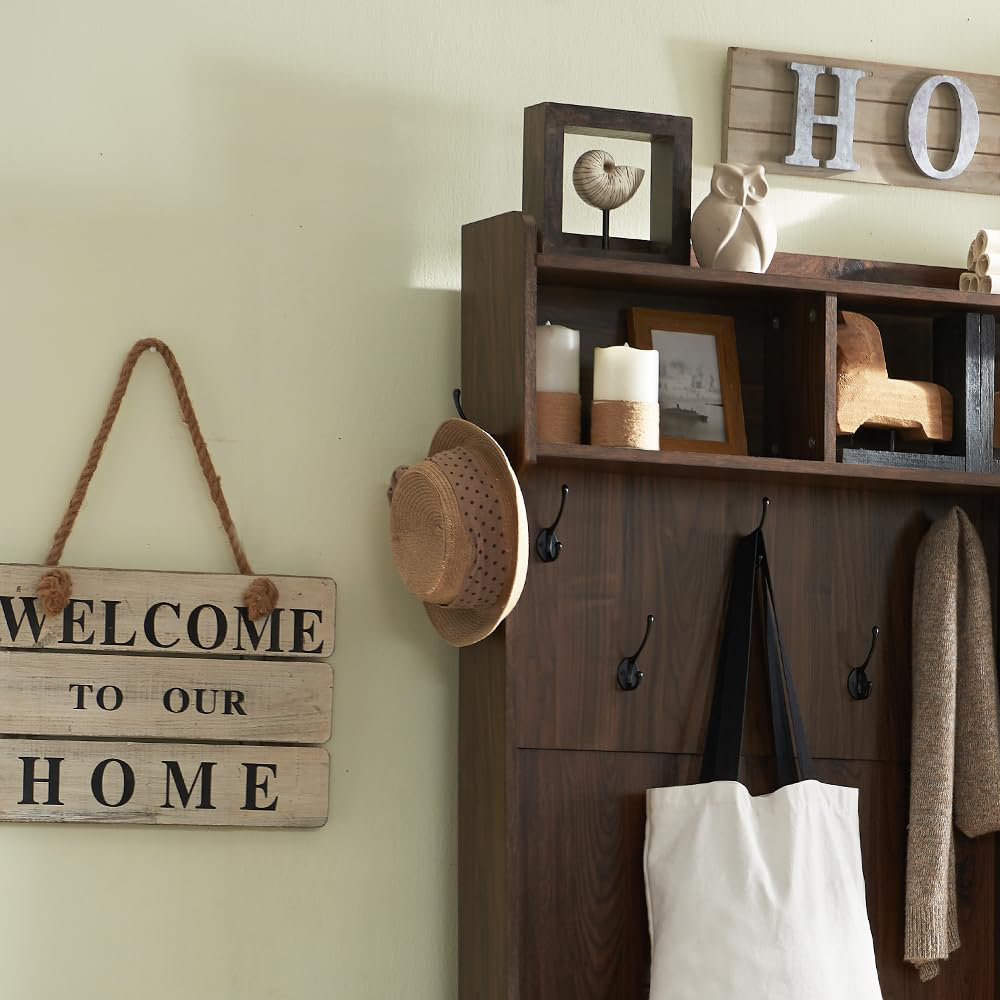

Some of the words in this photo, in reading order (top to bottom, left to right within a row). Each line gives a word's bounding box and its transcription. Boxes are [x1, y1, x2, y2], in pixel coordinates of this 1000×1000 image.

[0, 596, 324, 653] WELCOME
[69, 684, 124, 711] TO
[163, 687, 248, 715] OUR
[17, 756, 279, 811] HOME
